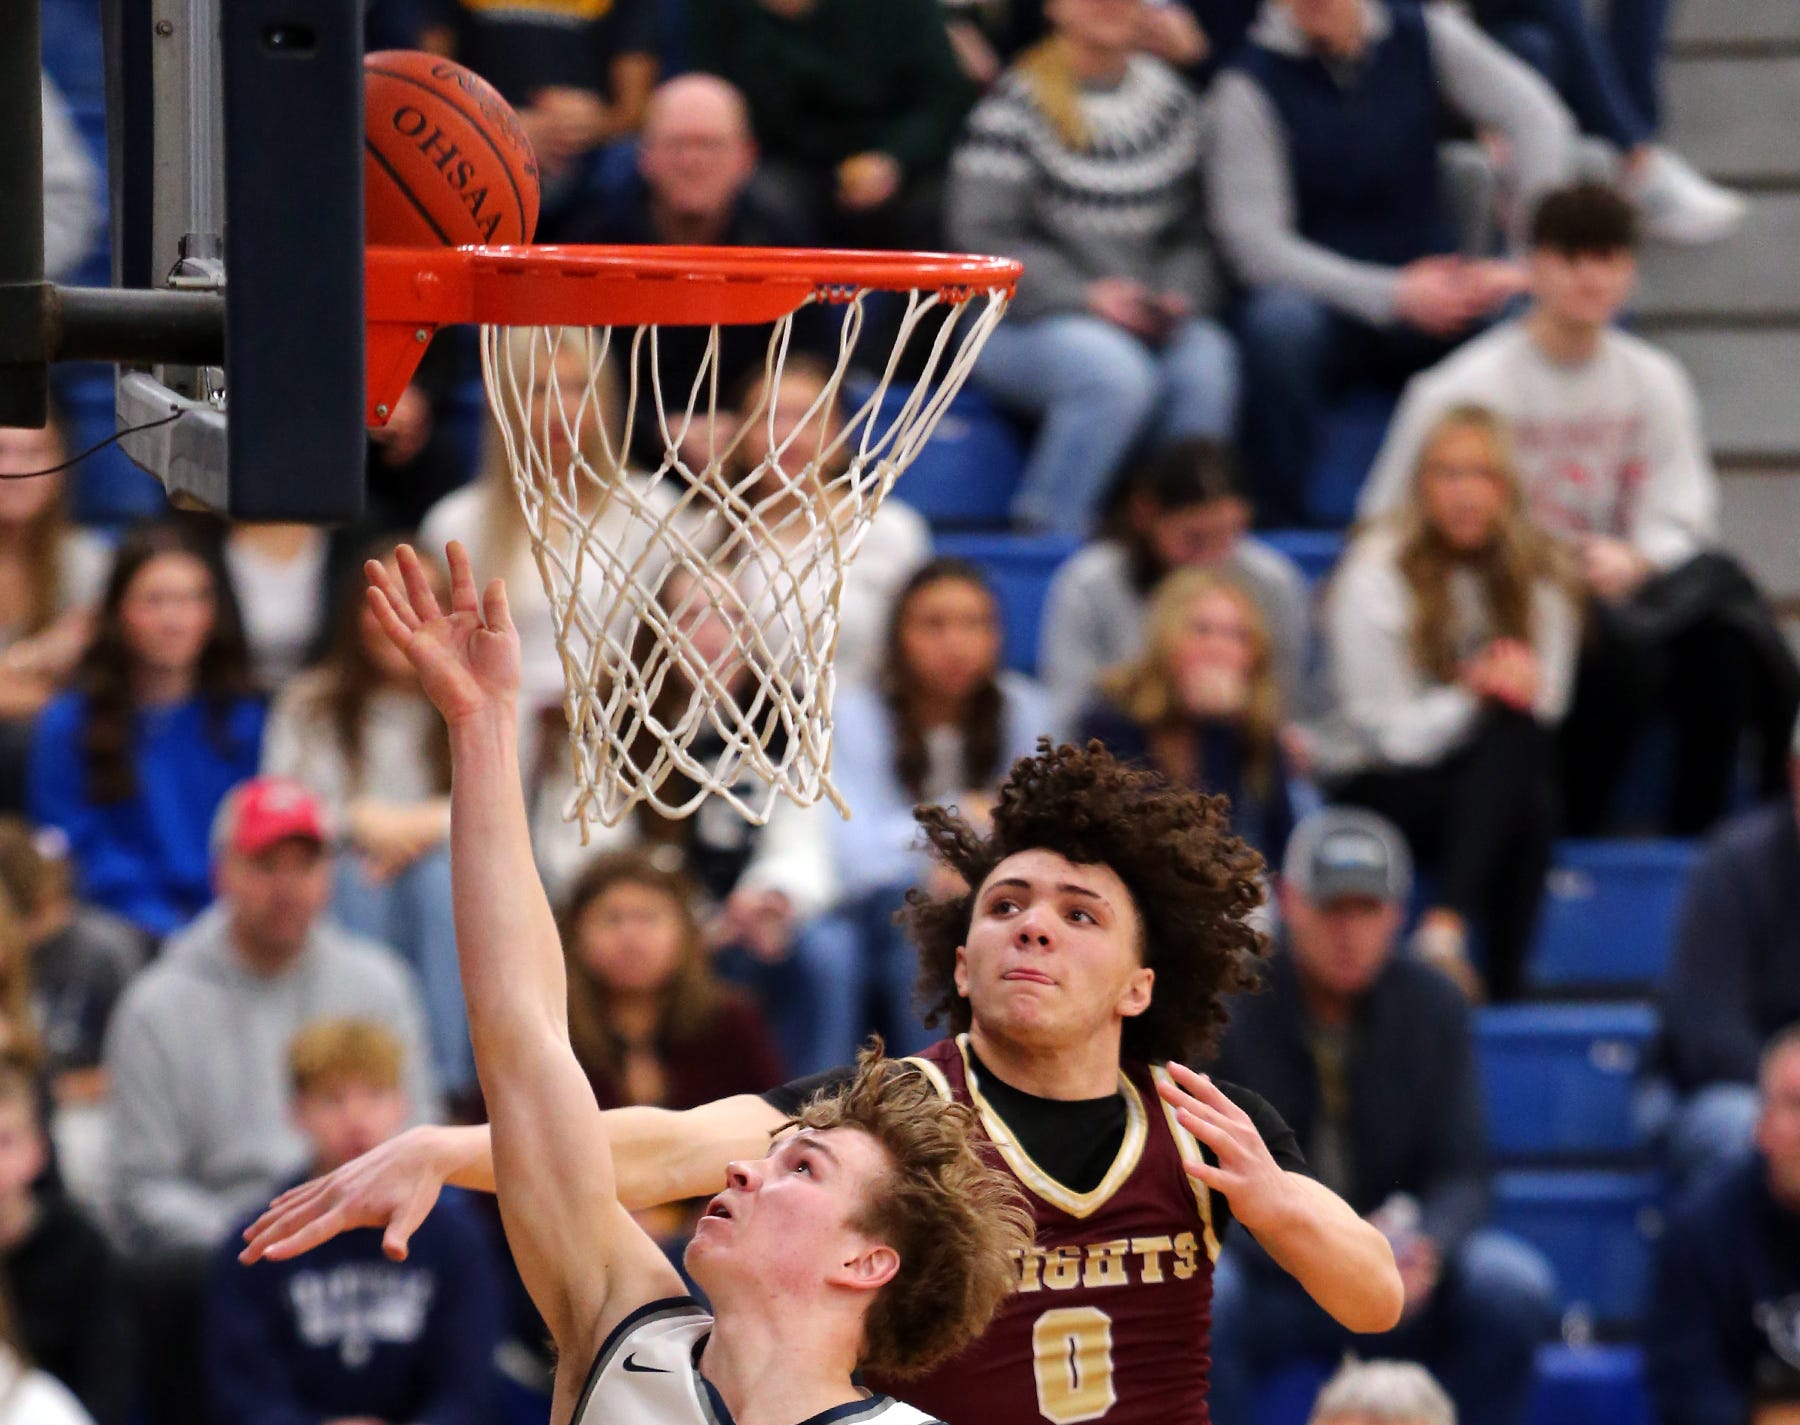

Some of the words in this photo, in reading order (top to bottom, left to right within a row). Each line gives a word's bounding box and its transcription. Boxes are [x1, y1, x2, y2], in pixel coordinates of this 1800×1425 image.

[392, 105, 502, 244] OHSAA
[1008, 1231, 1199, 1292] IGHTS
[1032, 1306, 1117, 1425] 0
